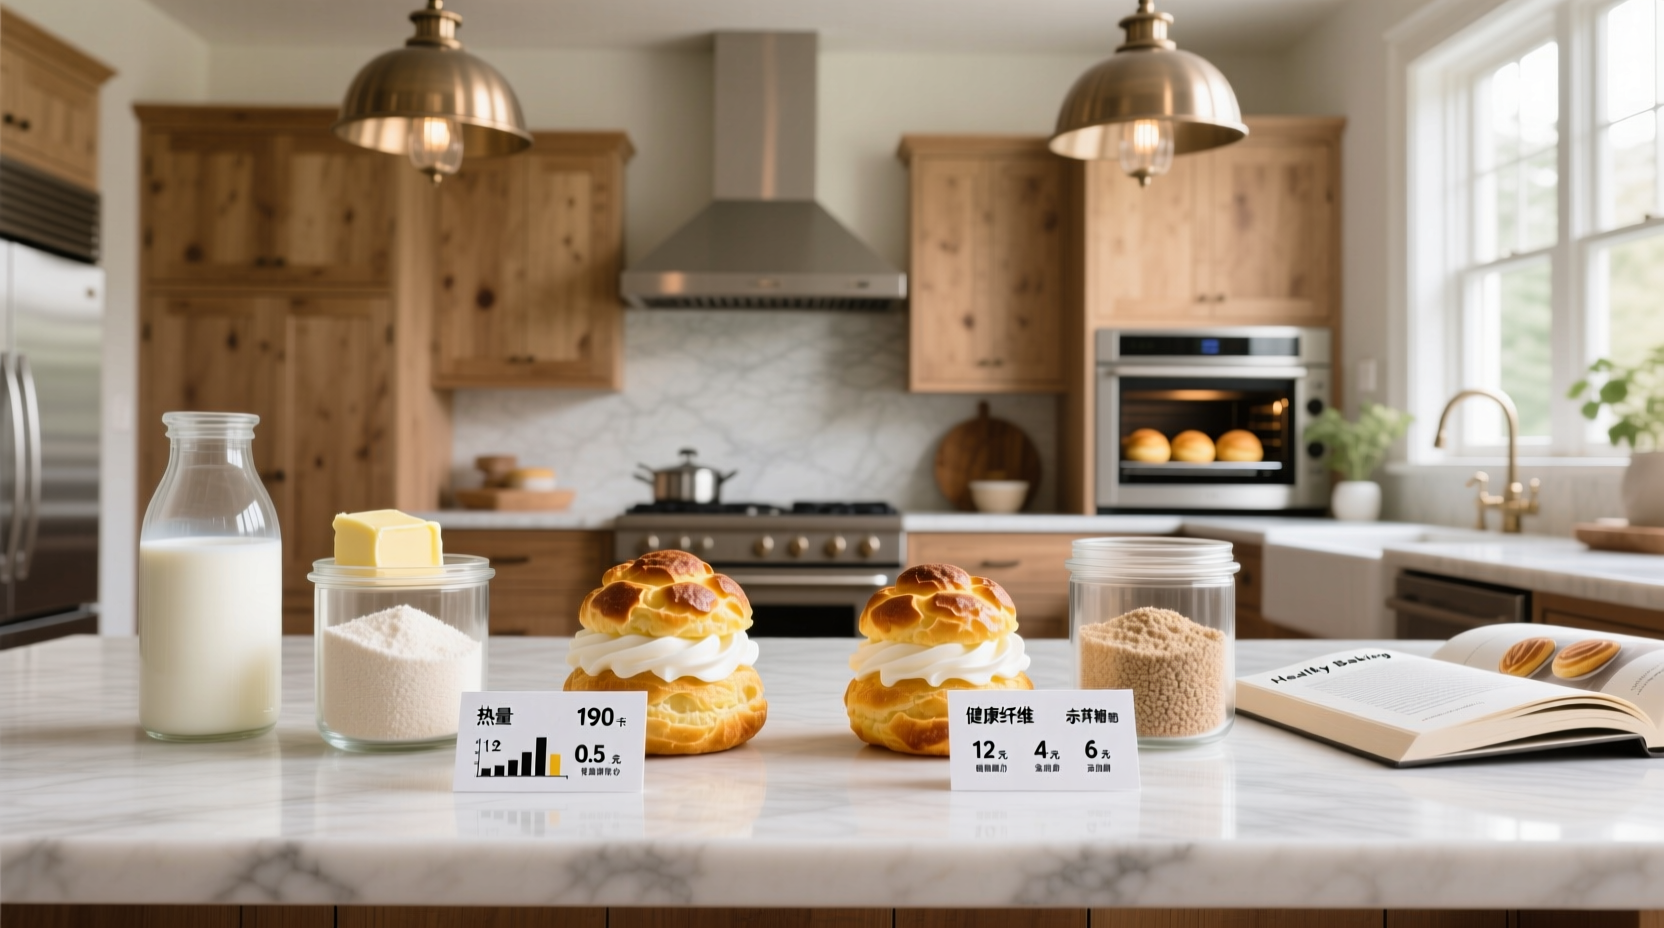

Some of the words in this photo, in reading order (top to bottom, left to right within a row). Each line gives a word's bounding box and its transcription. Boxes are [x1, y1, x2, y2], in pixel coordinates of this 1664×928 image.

[476, 705, 514, 727] 热量
[966, 706, 1035, 725] 健康纤维
